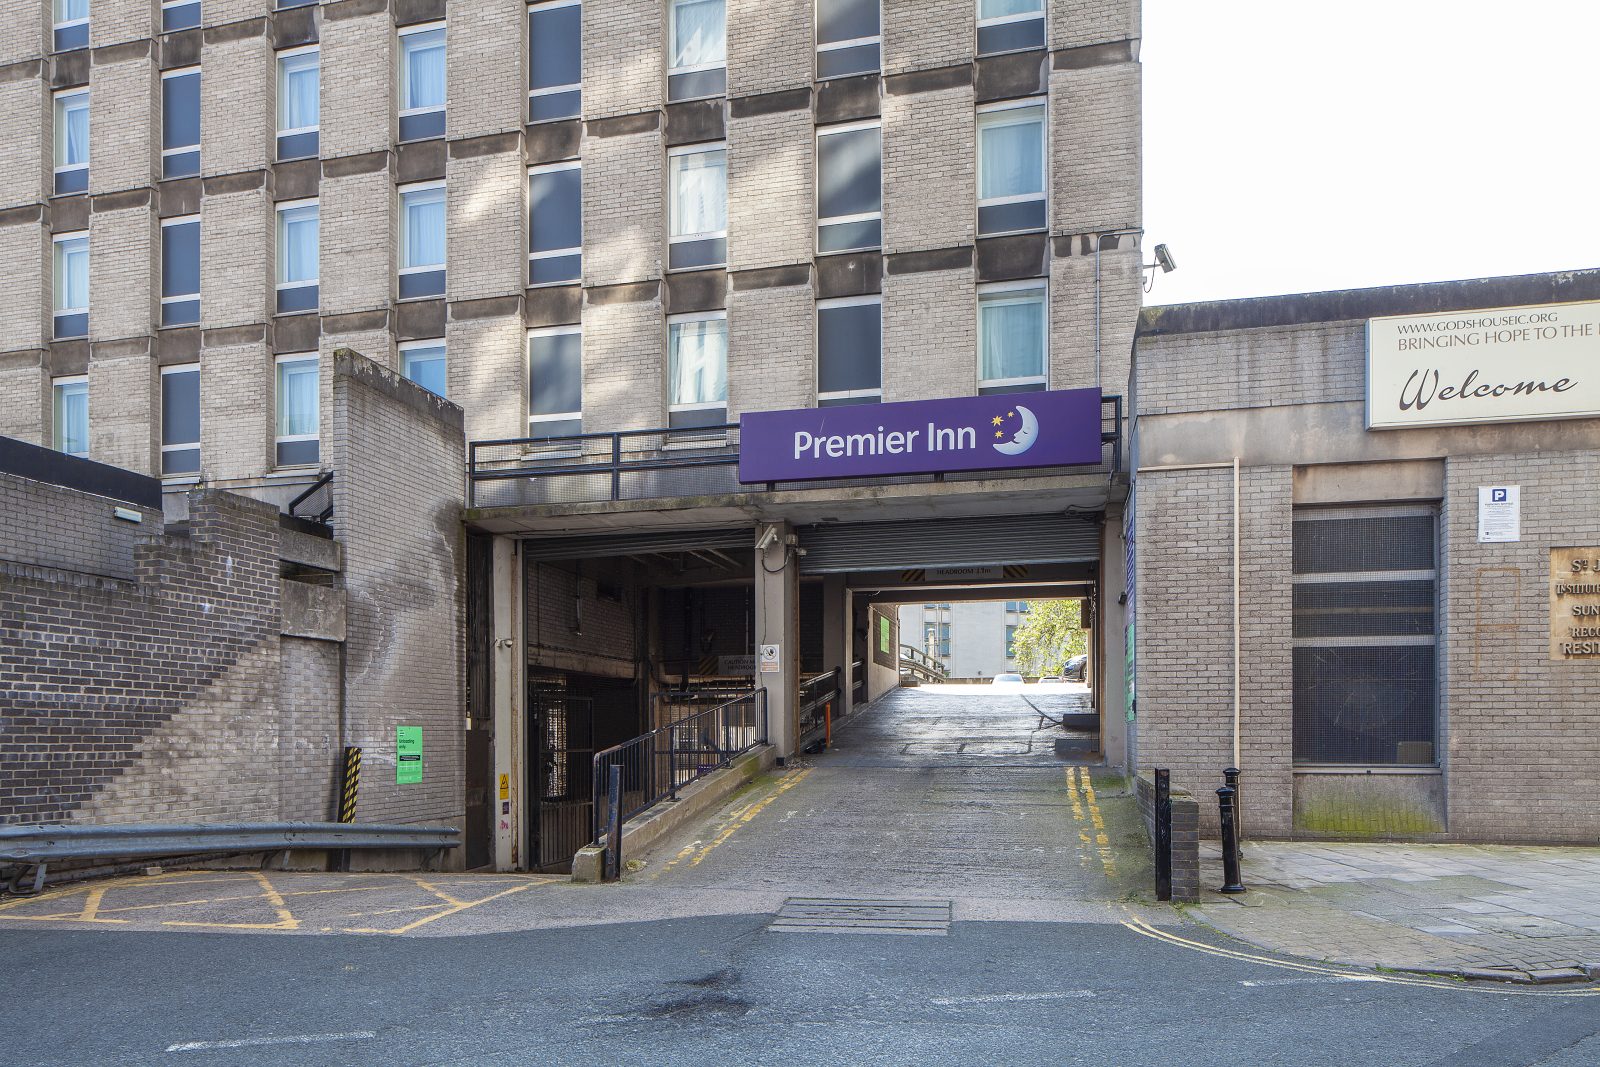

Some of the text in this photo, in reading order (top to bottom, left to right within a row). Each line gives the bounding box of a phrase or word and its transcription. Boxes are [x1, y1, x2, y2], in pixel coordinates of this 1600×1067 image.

[1397, 312, 1558, 335] WWW.GODSHOUSEIC.ORG
[1398, 332, 1480, 351] BRINGING
[1485, 327, 1531, 344] HOPE
[1535, 326, 1558, 340] TO
[1561, 323, 1593, 338] THE
[1399, 368, 1578, 411] Welcome
[794, 422, 976, 460] Premier Inn
